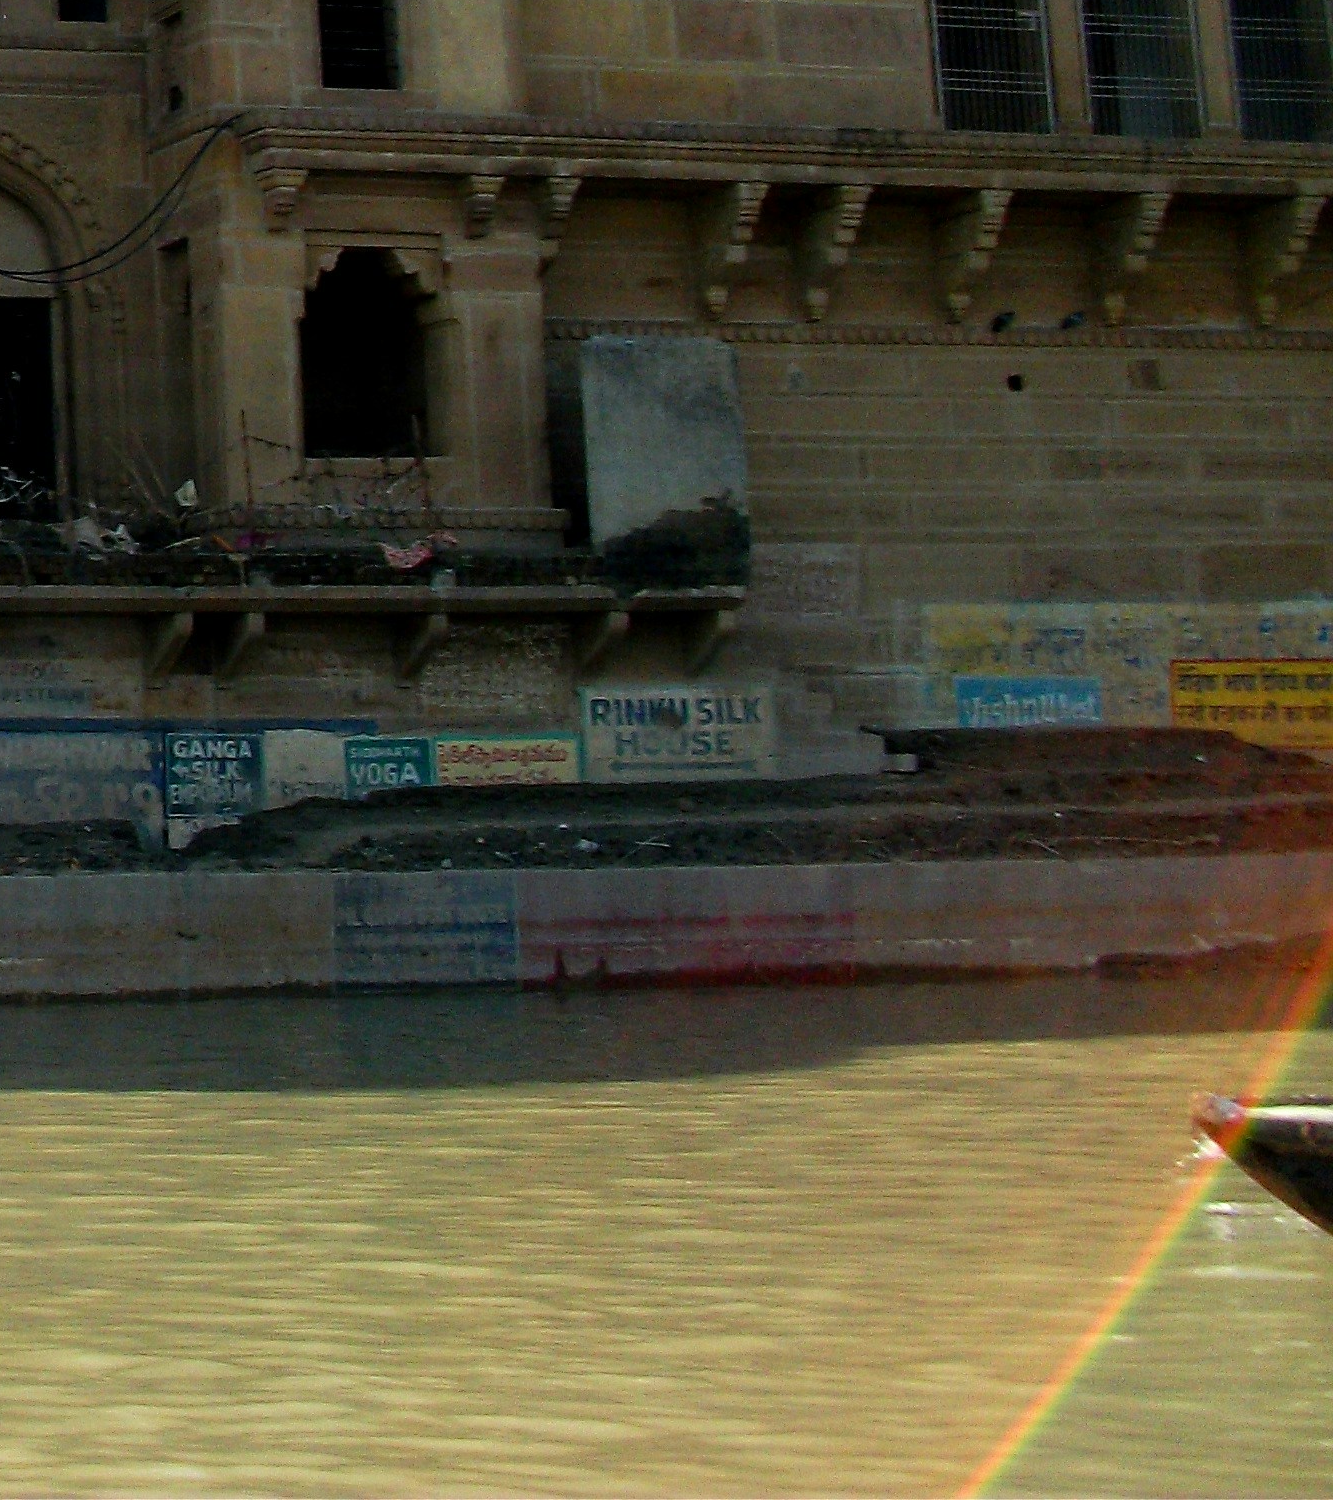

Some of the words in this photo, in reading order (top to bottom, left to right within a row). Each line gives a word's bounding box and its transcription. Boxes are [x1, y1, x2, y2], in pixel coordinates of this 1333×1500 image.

[694, 696, 762, 725] SILK
[172, 741, 252, 760] GANGA
[613, 730, 735, 757] HOUSE
[189, 762, 240, 782] SILK
[350, 762, 420, 787] YOGA
